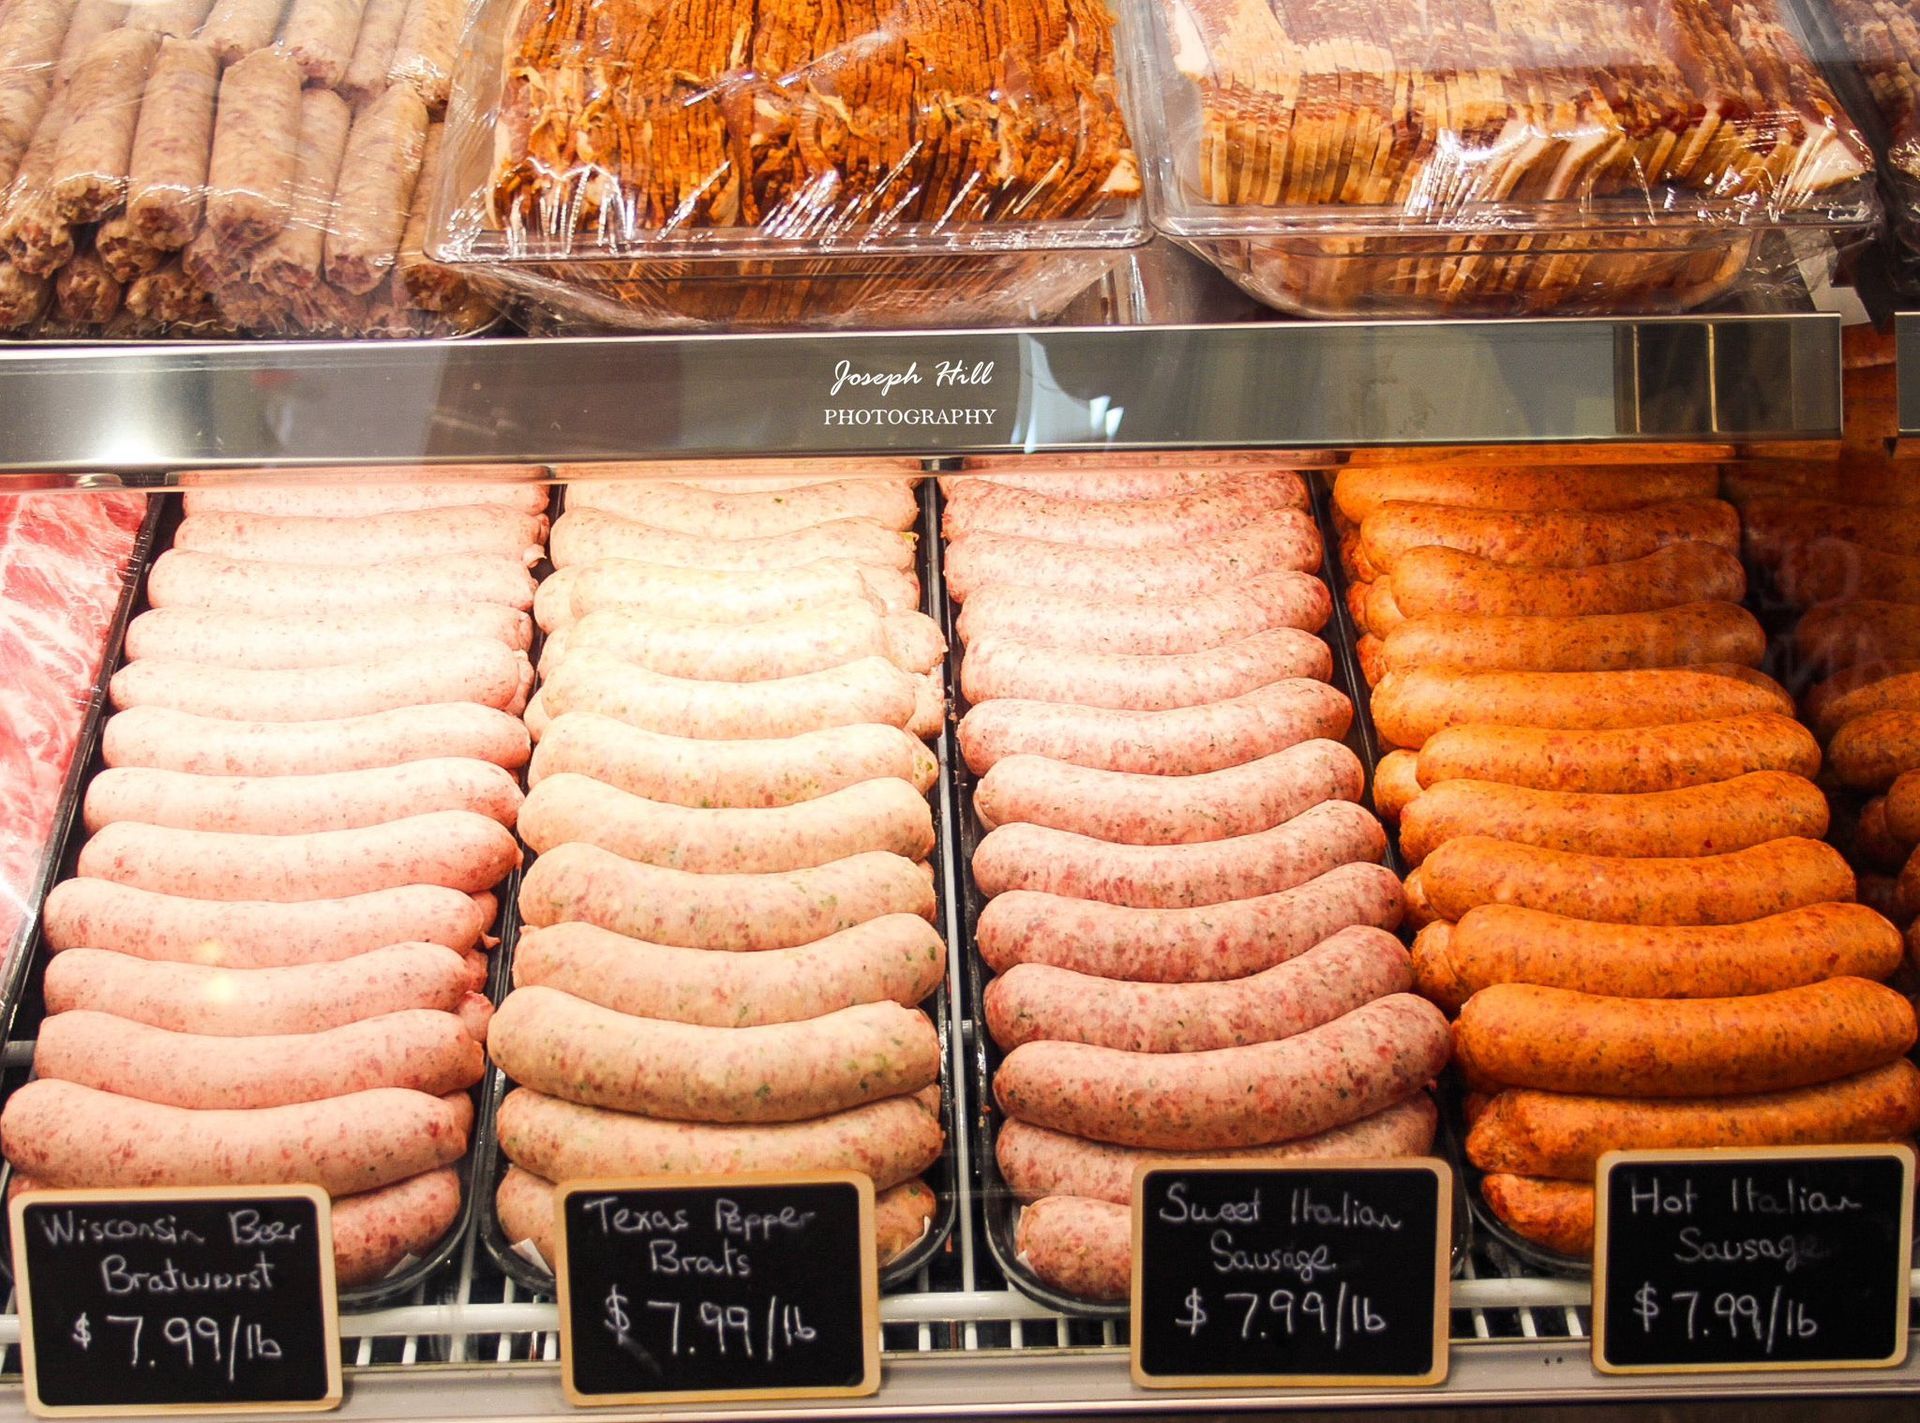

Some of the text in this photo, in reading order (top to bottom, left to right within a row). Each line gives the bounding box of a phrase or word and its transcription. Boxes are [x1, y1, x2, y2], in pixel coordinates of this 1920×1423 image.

[1159, 1182, 1401, 1229] Sweet Italian
[1631, 1177, 1862, 1214] Hot Italian
[41, 1209, 302, 1246] Wisconsin Beer
[584, 1197, 815, 1240] Texas Pepper
[101, 1251, 275, 1294] Bratwurst
[649, 1239, 751, 1277] Brats
